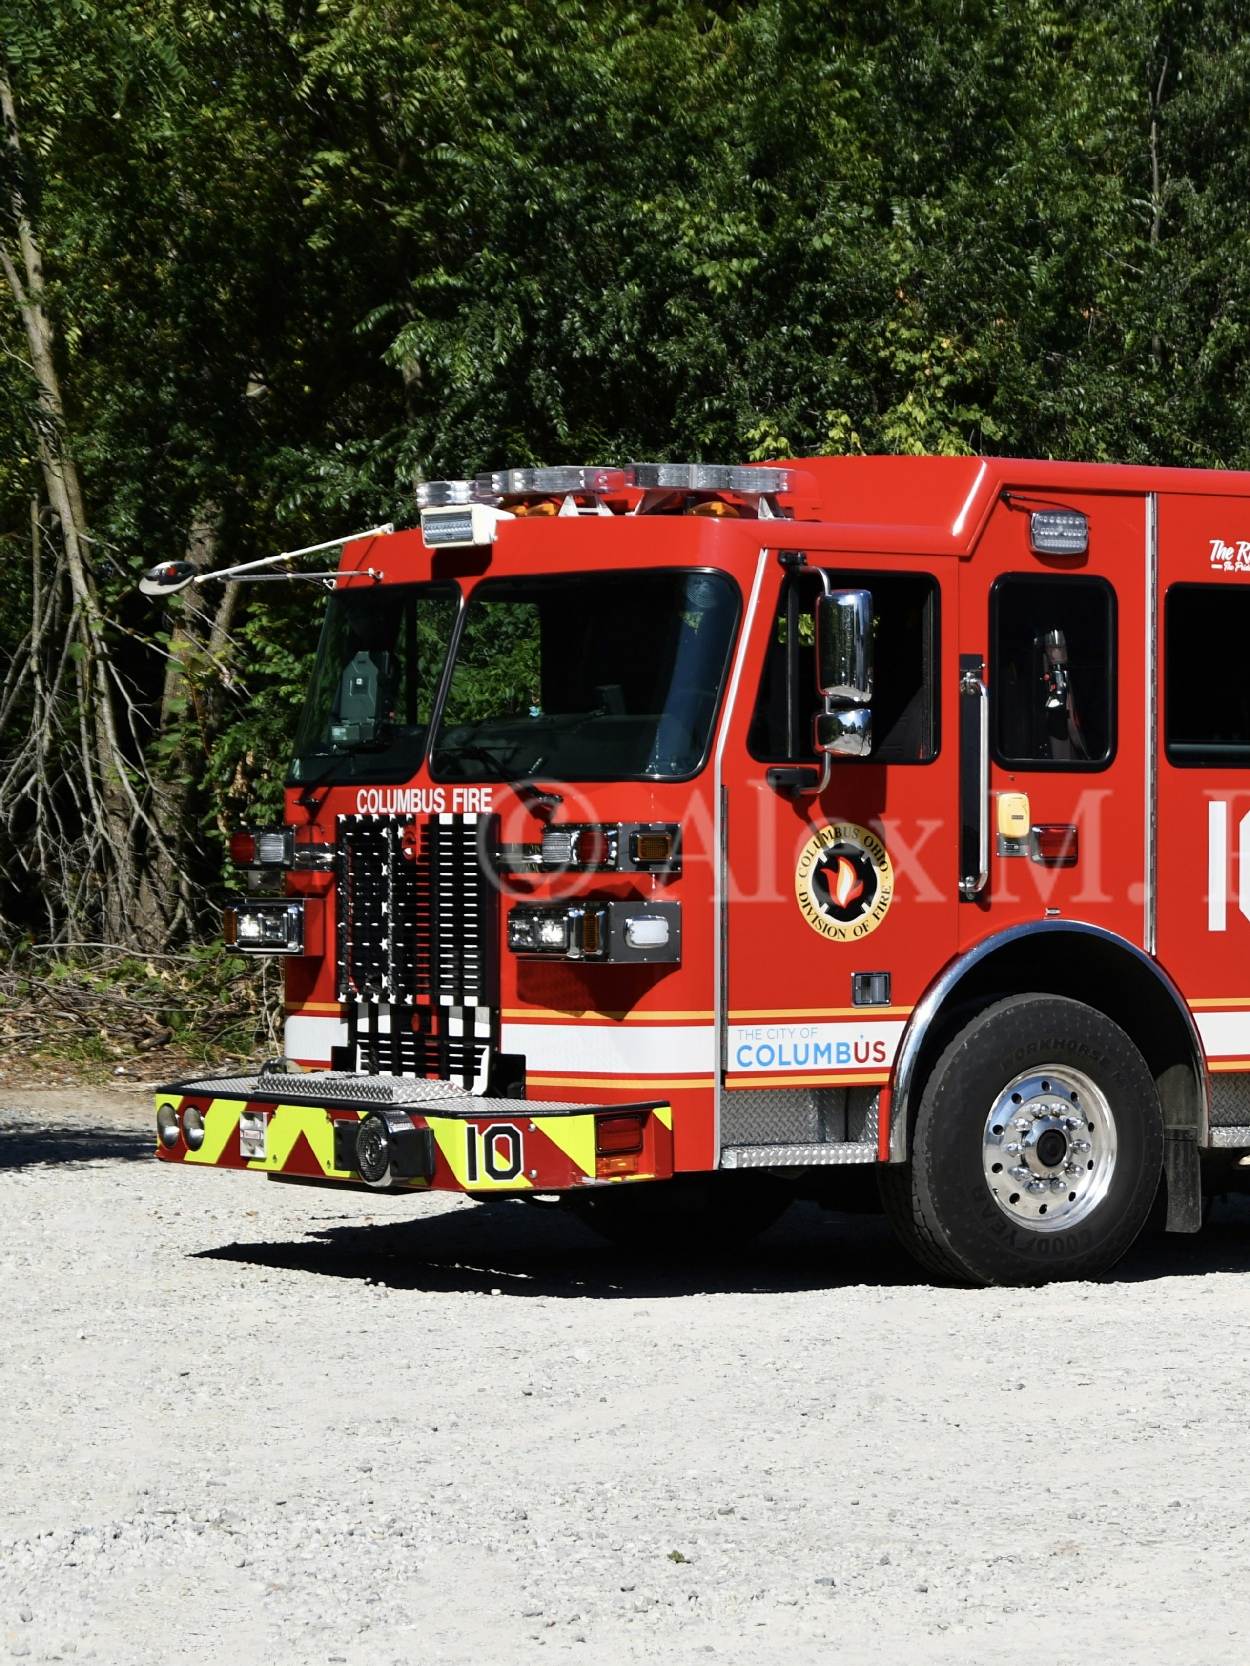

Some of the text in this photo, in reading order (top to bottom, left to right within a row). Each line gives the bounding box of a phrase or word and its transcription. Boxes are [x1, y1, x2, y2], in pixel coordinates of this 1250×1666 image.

[1209, 539, 1235, 562] The
[1234, 562, 1250, 572] Pride
[356, 787, 493, 813] COLUMBUS FIRE
[799, 826, 889, 879] COLUMBUS OHIO
[799, 885, 892, 940] DIVISION OF FIRE
[737, 1027, 818, 1041] THE CITY OF
[736, 1040, 887, 1067] COLUMBUS
[1001, 1038, 1112, 1073] WORKHORSE
[465, 1123, 524, 1182] 10
[972, 1185, 1094, 1256] GOODYEAR
